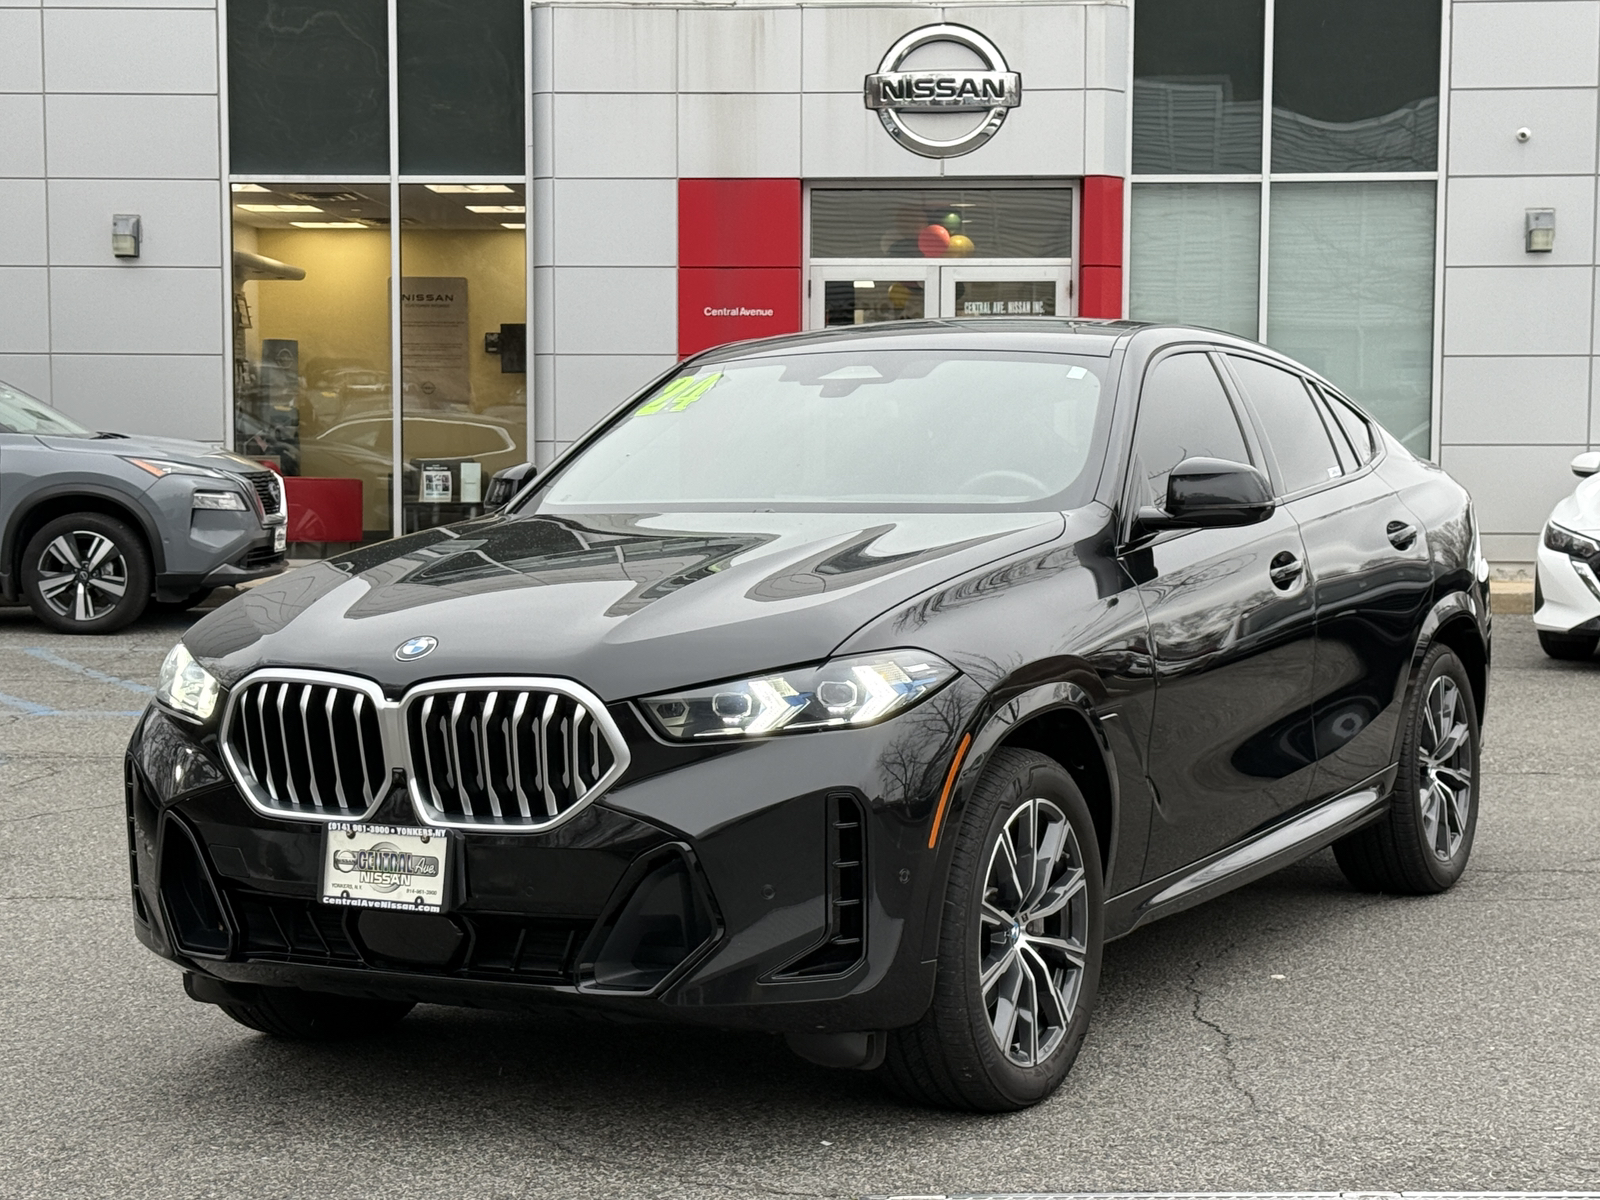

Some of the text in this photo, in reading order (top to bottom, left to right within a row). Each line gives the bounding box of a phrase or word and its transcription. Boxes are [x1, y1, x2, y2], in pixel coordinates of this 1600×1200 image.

[880, 78, 1005, 100] NISSAN
[401, 293, 454, 302] NISSAN
[703, 306, 774, 317] Central Avenue
[964, 300, 1046, 315] CENTRAL AVE. NISSAN INC.
[328, 822, 350, 831] (914)
[358, 849, 436, 874] CENTRAL Ave.
[360, 871, 411, 886] NISSAN
[323, 896, 440, 912] CentralAveNissan.com
